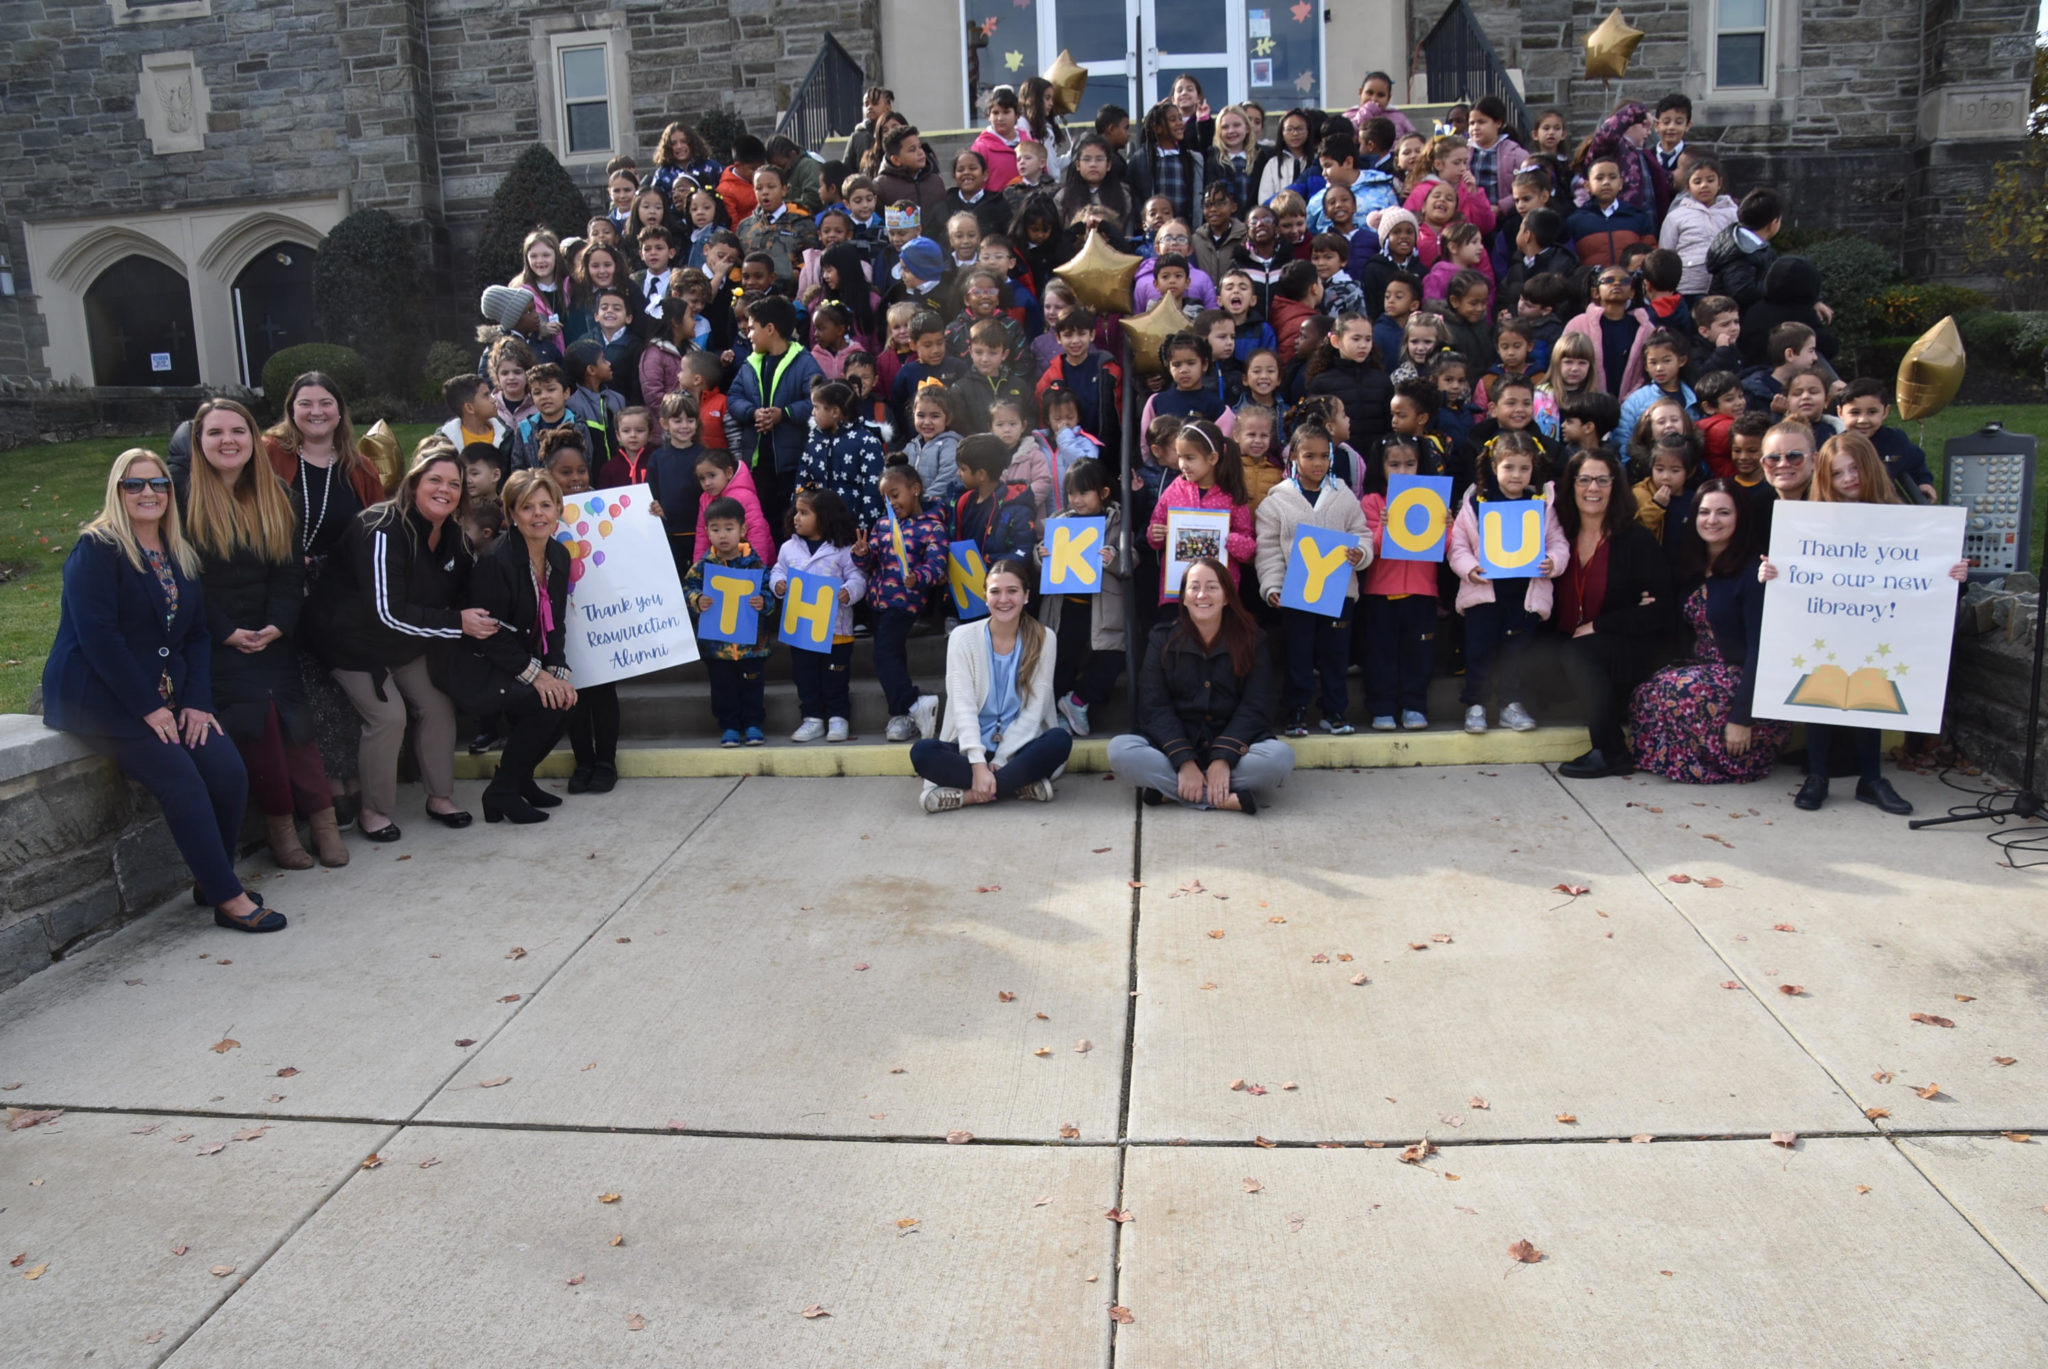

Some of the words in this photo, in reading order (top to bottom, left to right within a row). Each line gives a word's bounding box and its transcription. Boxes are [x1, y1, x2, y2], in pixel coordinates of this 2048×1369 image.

[1798, 539, 1868, 559] Thank
[1875, 545, 1920, 565] you
[1789, 564, 1824, 585] for
[1832, 572, 1875, 588] our
[1883, 575, 1933, 591] new
[581, 597, 632, 622] Thank
[635, 593, 664, 614] you
[1807, 597, 1897, 623] library!
[587, 616, 680, 649] Resurrection
[609, 643, 669, 670] Alumni
